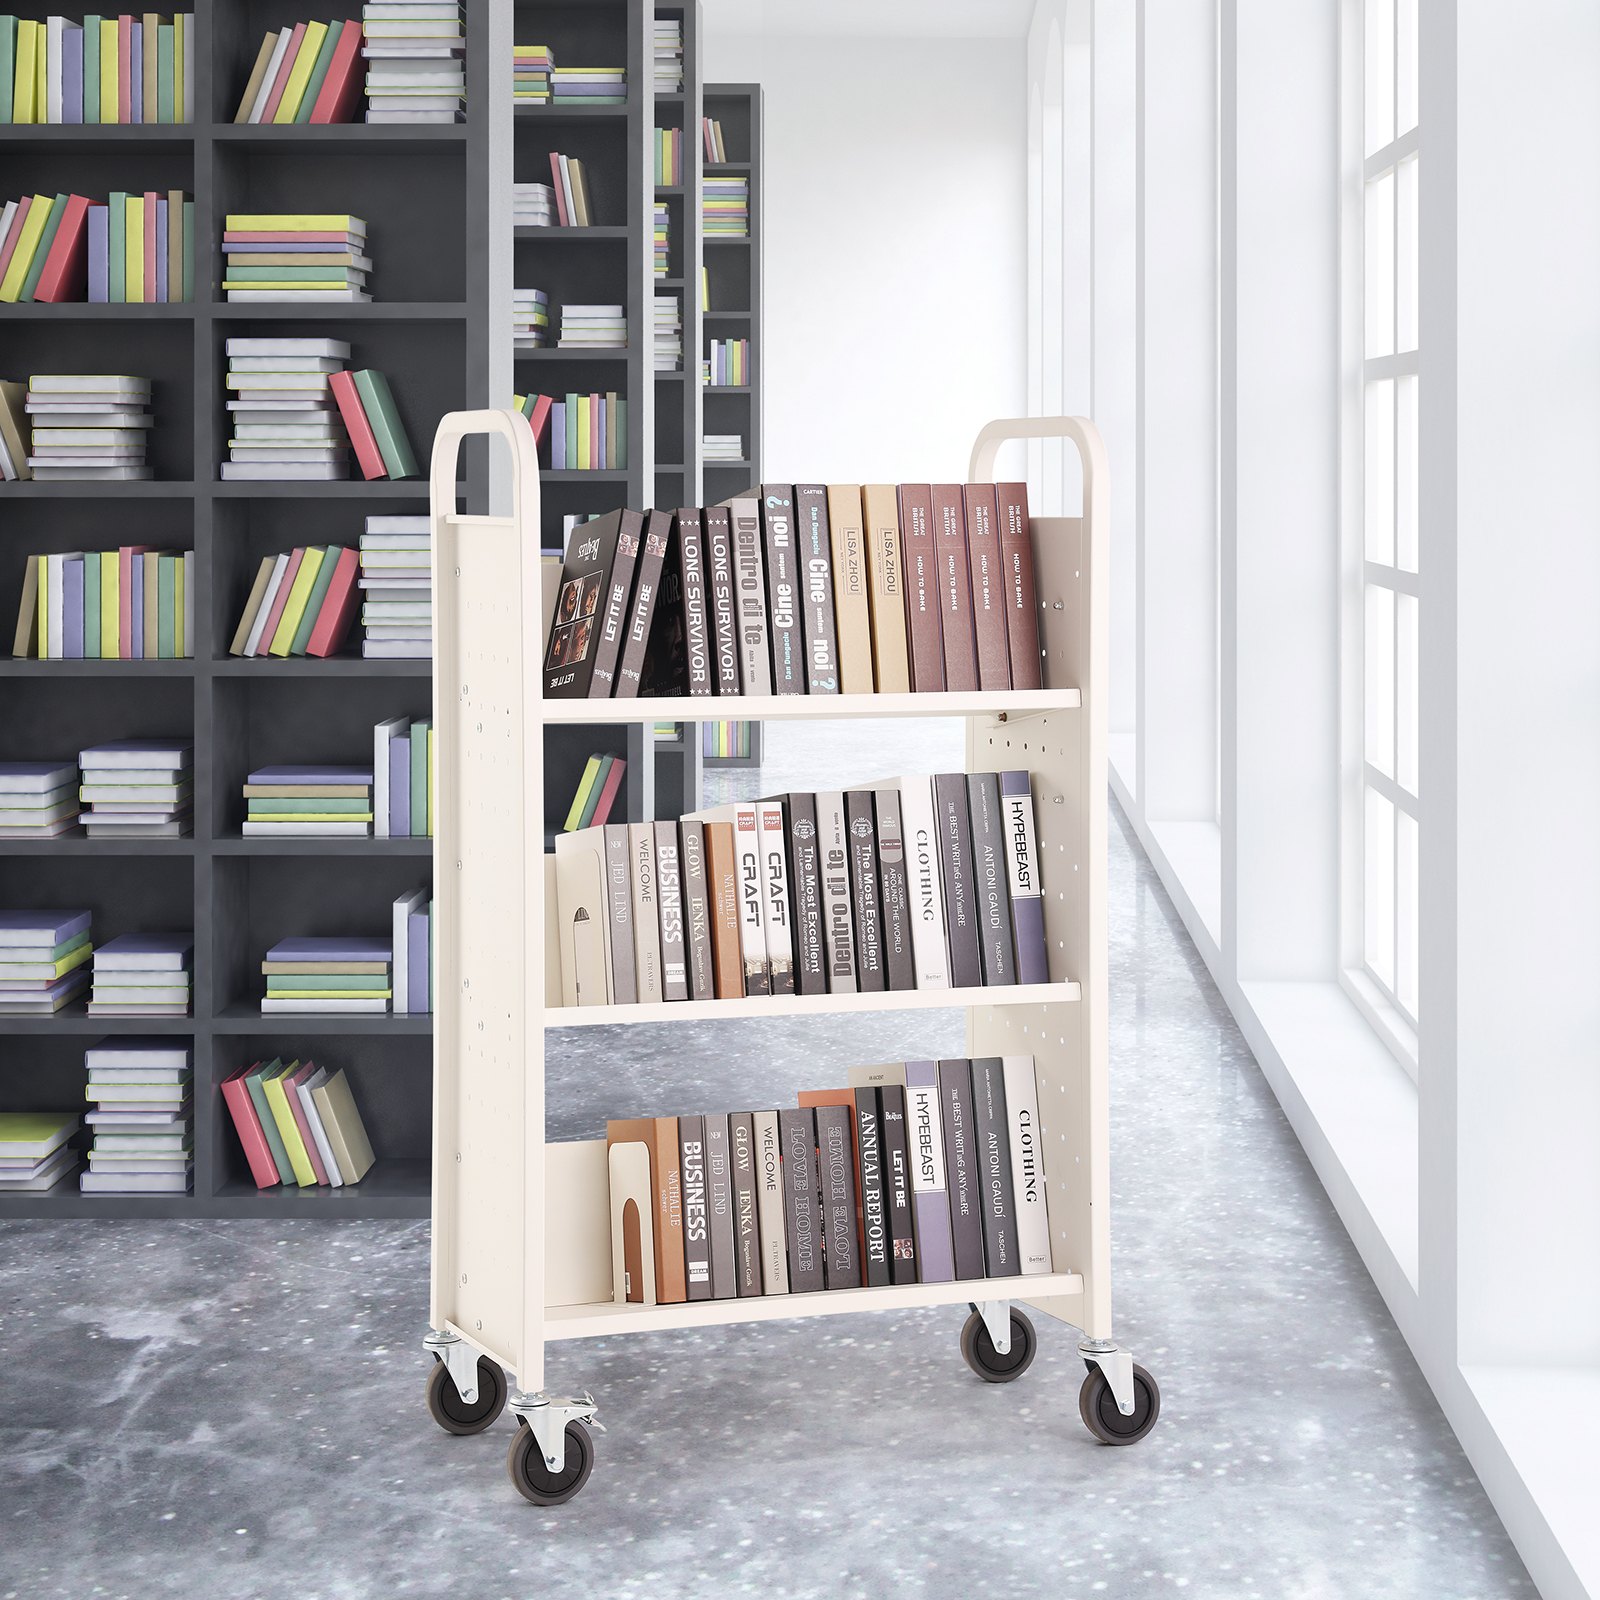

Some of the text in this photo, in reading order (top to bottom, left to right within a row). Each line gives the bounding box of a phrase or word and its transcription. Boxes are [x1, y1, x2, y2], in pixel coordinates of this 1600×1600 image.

[769, 516, 788, 547] noi
[737, 517, 763, 644] Dentro di te
[808, 558, 828, 603] Cine
[848, 531, 859, 592] LISA ZHOU
[884, 532, 896, 592] LISA ZHOU
[918, 578, 924, 587] TO
[950, 577, 956, 586] TO
[982, 576, 988, 585] TO
[1015, 575, 1021, 584] TO
[605, 584, 624, 641] LET IT BE
[632, 584, 652, 641] LET IT BE
[684, 536, 705, 682] LONE SURVIVOR
[713, 535, 734, 681] LONE SURVIVOR
[774, 584, 793, 628] Cine
[550, 677, 558, 688] BE
[565, 673, 574, 684] LET
[813, 640, 833, 670] noi
[862, 844, 872, 869] The
[950, 816, 958, 840] BEST
[1012, 802, 1030, 890] HYPEBEAST
[640, 838, 651, 903] WELCOME
[799, 857, 807, 891] Lamentable
[804, 846, 814, 871] The
[917, 829, 934, 921] CLOTHING
[984, 845, 1002, 929] ANTONI GAUDÍ
[611, 861, 627, 923] JED LIND
[659, 846, 682, 944] BUSINESS
[724, 874, 736, 929] NATHALIE
[743, 852, 760, 927] CRAFT
[768, 852, 785, 926] CRAFT
[805, 875, 816, 908] Most
[827, 850, 852, 977] Dentro di te
[863, 873, 874, 906] Most
[691, 897, 705, 942] IENKA
[808, 911, 820, 973] Excellent
[866, 909, 879, 971] Excellent
[995, 941, 1003, 974] TASCHEN
[885, 1111, 902, 1120] BEATLES
[916, 1093, 934, 1184] HYPEBEAST
[953, 1102, 962, 1128] BEST
[711, 1152, 726, 1215] JED LIND
[764, 1127, 776, 1191] WELCOME
[892, 1150, 905, 1208] LET IT BE
[988, 1132, 1006, 1217] ANTONI GAUDÍ
[1019, 1109, 1037, 1203] CLOTHING
[668, 1170, 680, 1226] NATHALIE
[684, 1141, 706, 1242] BUSINESS
[739, 1189, 752, 1236] IENKA
[791, 1128, 813, 1271] LOVE HOME
[828, 1126, 850, 1270] LOVE HOME
[860, 1110, 884, 1263] ANNUAL REPORT
